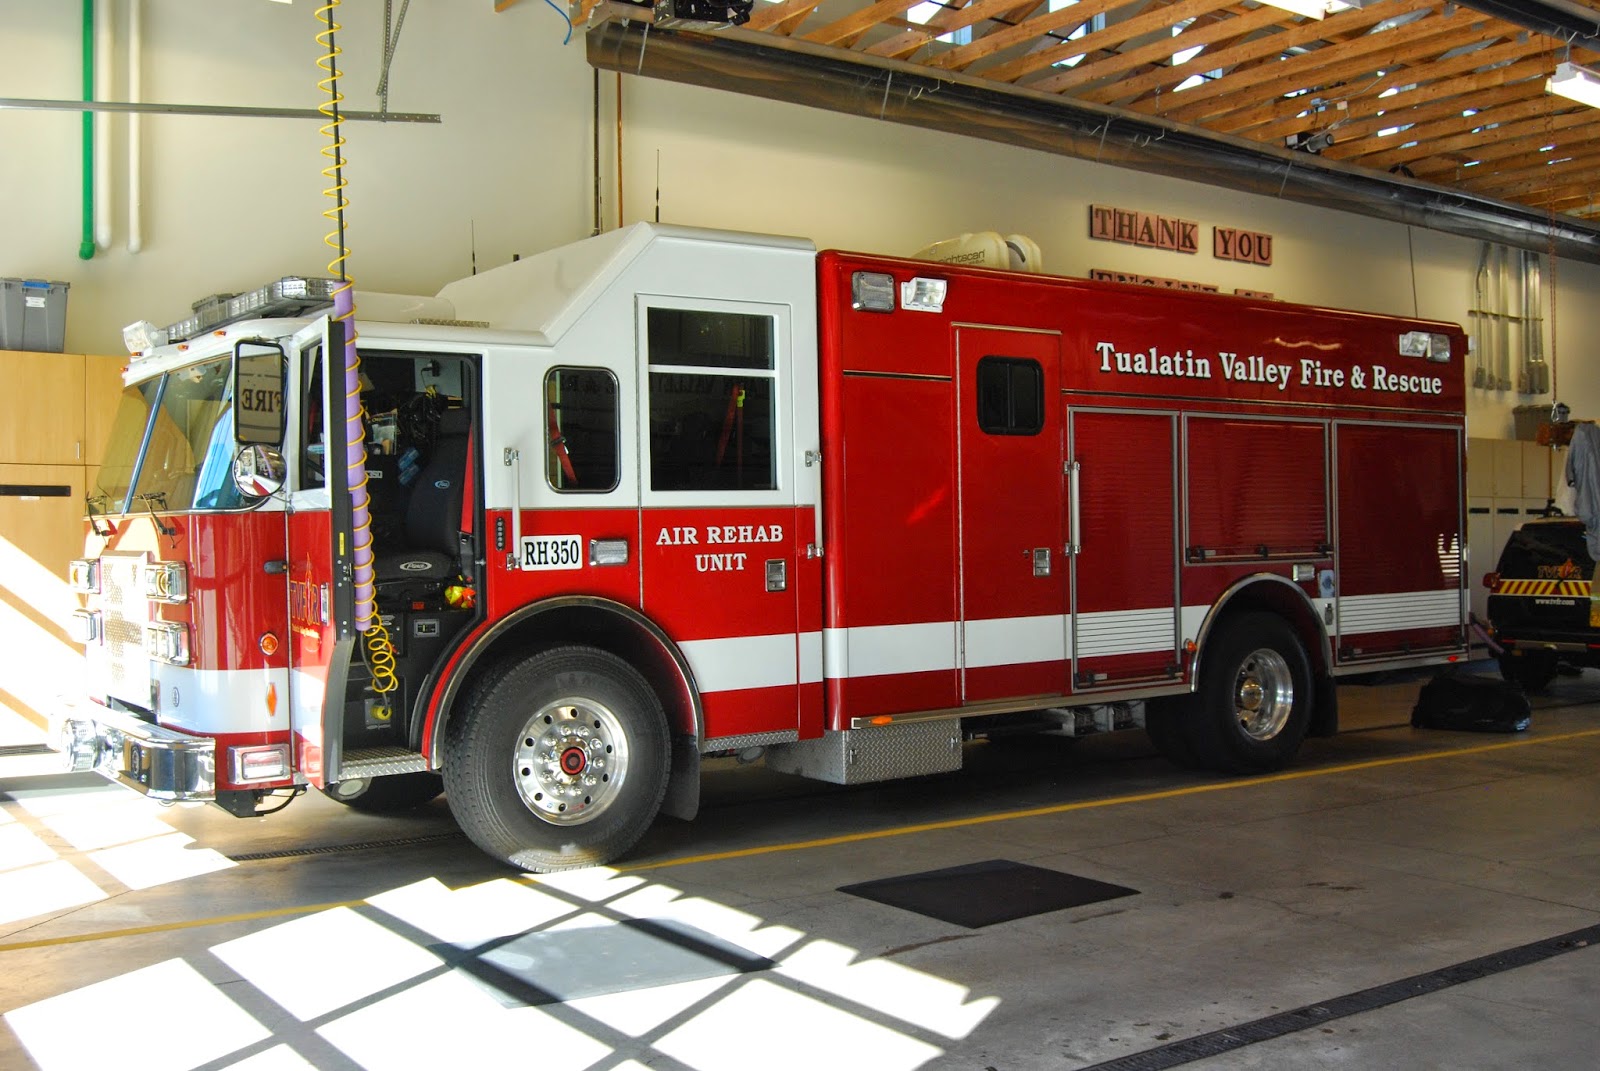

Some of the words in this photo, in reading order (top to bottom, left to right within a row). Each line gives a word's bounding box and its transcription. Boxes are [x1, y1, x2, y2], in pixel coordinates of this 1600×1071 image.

[1095, 207, 1198, 250] THANK
[1217, 229, 1272, 261] YOU
[1097, 342, 1211, 378] Tualatin
[1219, 352, 1292, 391] Valley
[1300, 359, 1344, 387] Fire
[1350, 365, 1366, 389] &
[1372, 365, 1442, 394] Rescue
[656, 527, 699, 546] AIR
[706, 525, 784, 544] REHAB
[524, 540, 579, 566] RH350
[694, 553, 748, 572] UNIT
